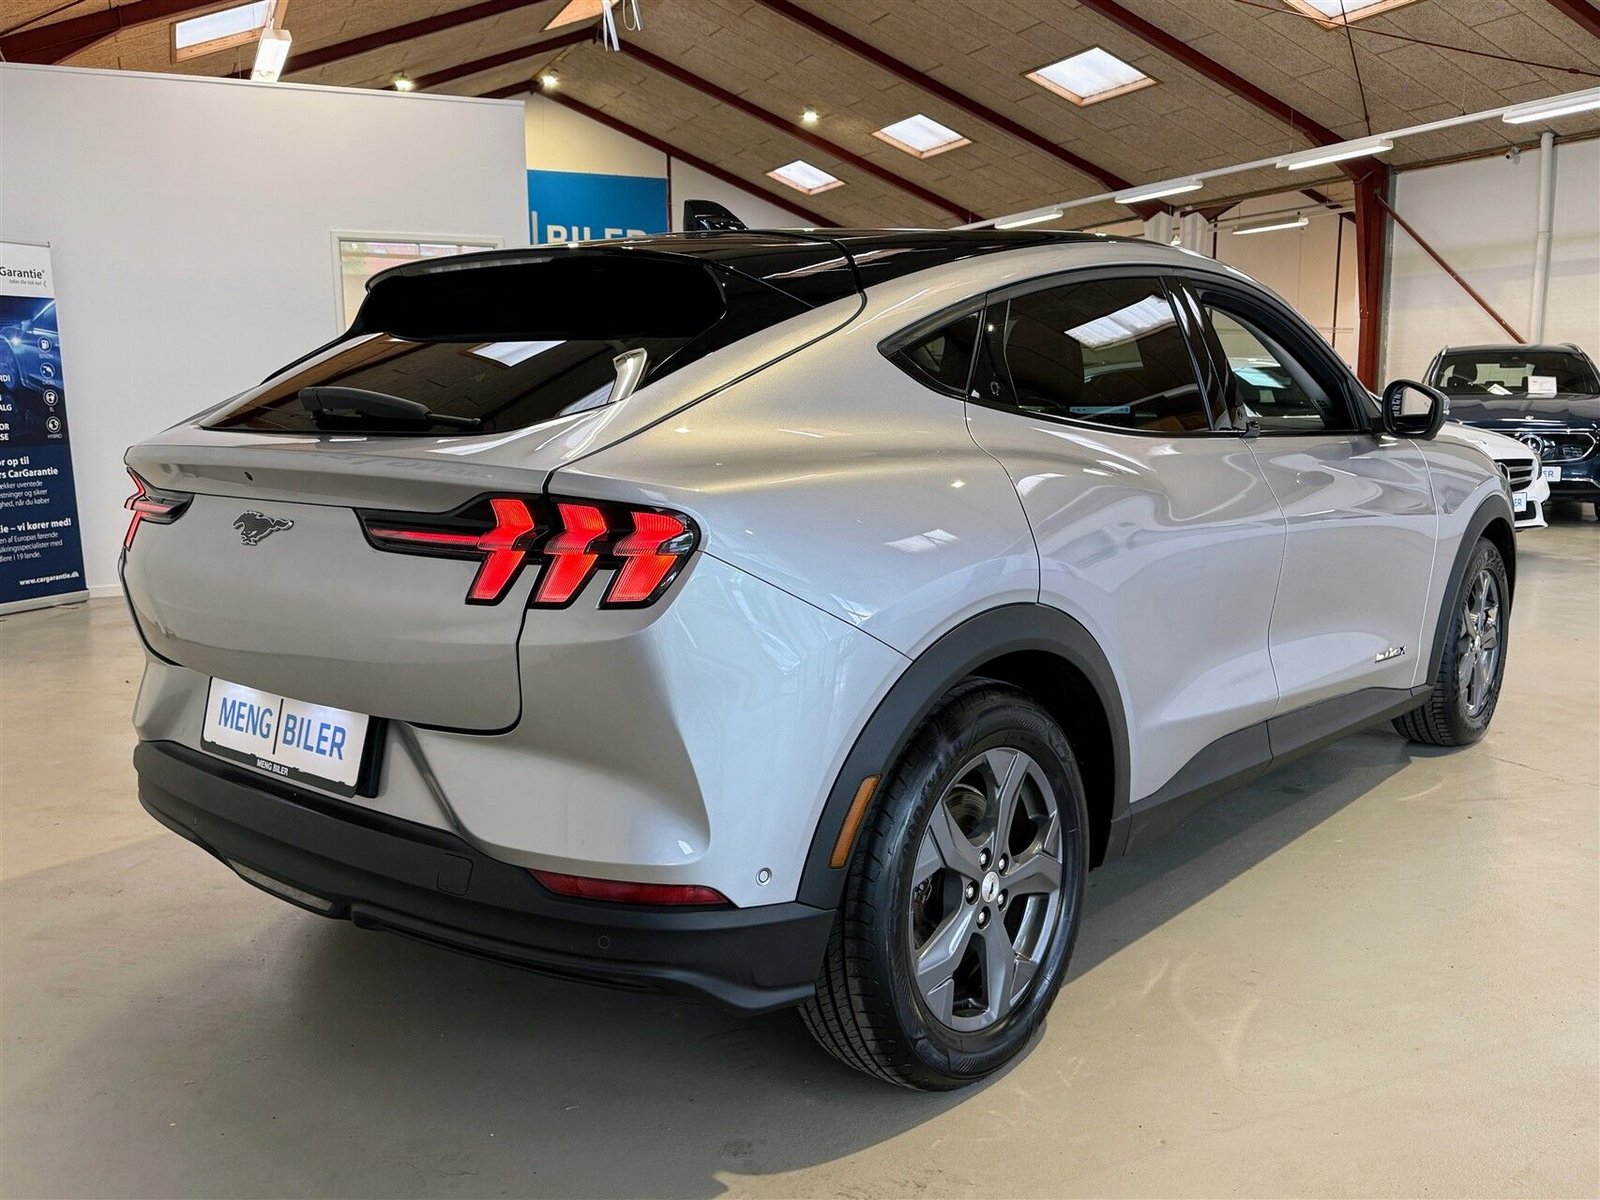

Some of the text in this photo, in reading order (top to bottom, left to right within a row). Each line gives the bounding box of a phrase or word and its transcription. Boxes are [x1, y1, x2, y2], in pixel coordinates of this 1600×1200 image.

[547, 224, 647, 244] BILE
[7, 459, 19, 467] op
[20, 456, 30, 465] til
[8, 467, 58, 478] CarGarantie
[17, 522, 26, 531] vi
[27, 520, 49, 530] kører
[51, 517, 72, 528] med!
[19, 571, 80, 585] www.cargarantie.dk
[218, 697, 347, 760] MENG BILER
[257, 759, 289, 776] MENG BILER
